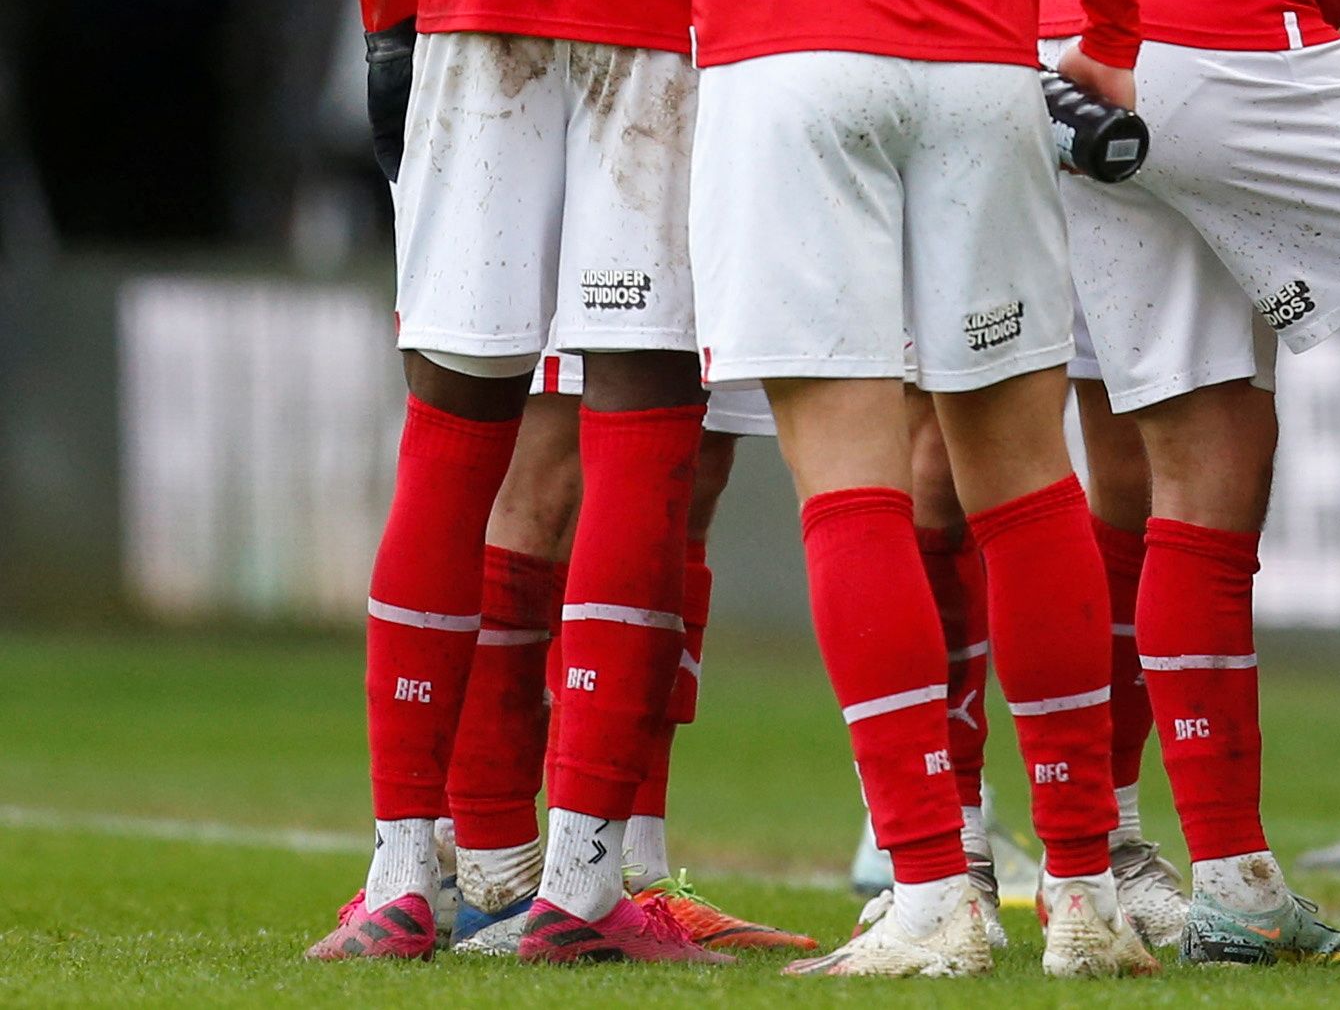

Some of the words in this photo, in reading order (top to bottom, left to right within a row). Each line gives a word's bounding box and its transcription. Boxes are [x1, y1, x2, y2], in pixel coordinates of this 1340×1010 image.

[580, 269, 649, 288] KIDSUPER
[581, 286, 646, 307] STUDIOS
[394, 676, 432, 704] BFC
[566, 666, 597, 692] BFC
[1174, 717, 1210, 741] BFC
[1034, 761, 1069, 784] BFC
